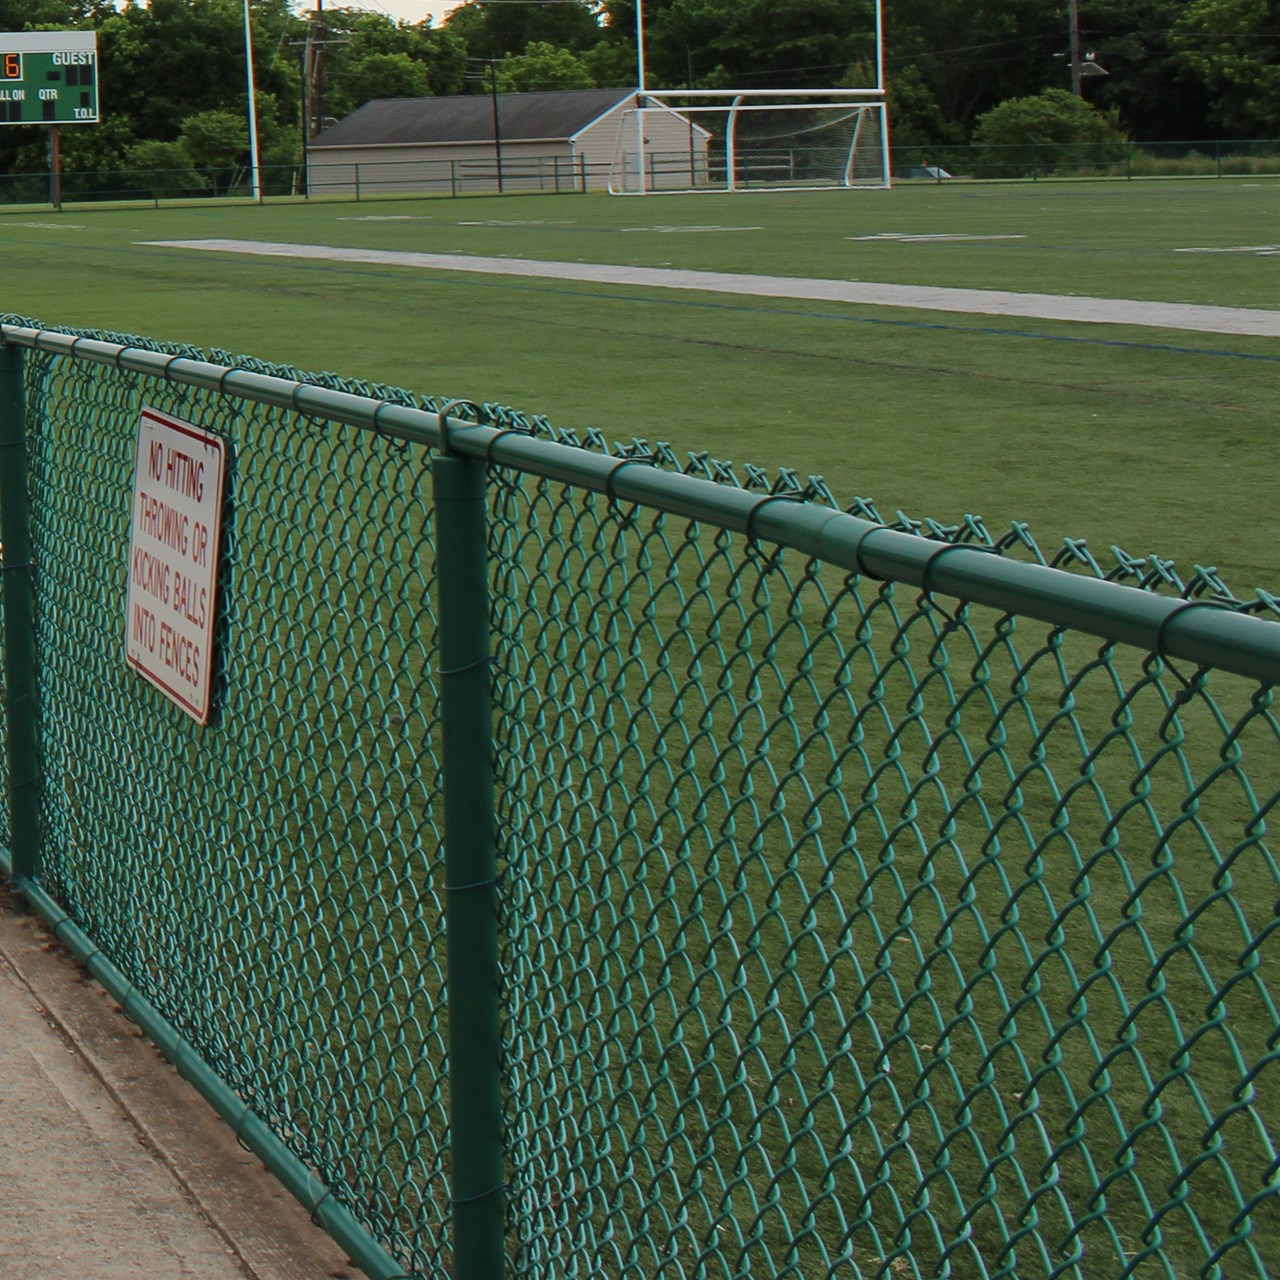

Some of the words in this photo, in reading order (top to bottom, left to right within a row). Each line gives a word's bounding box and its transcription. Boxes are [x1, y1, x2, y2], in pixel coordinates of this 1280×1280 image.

[52, 51, 94, 66] GUEST
[12, 89, 25, 101] ON
[38, 88, 58, 100] QTR
[149, 439, 162, 482] NO
[165, 448, 205, 503] HITTING
[139, 491, 188, 557] THROWING
[192, 520, 208, 568] OR
[133, 545, 170, 605] KICKING
[173, 570, 207, 630] BALLS
[133, 602, 156, 653] INTO
[158, 622, 200, 688] FENCES
